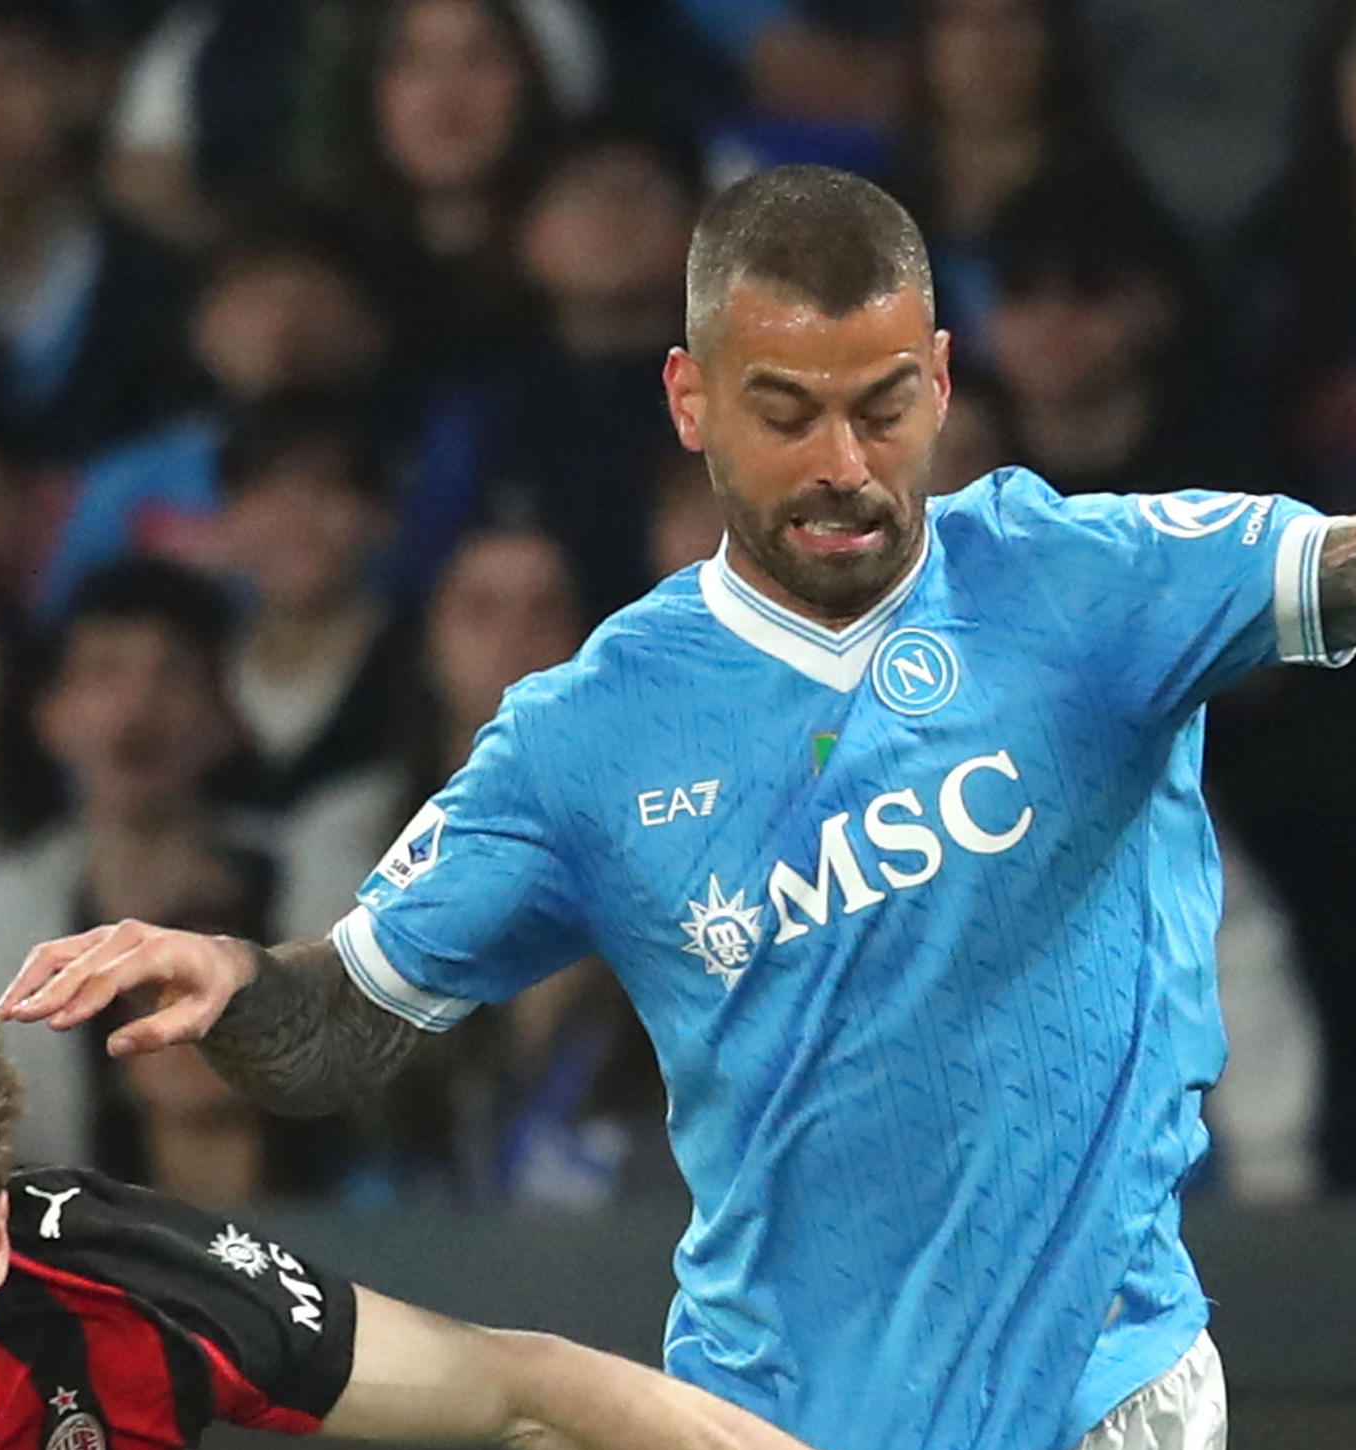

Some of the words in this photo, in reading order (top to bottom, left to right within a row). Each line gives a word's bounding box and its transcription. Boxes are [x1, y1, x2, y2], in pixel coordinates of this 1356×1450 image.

[891, 648, 936, 696] N
[637, 778, 720, 827] EA7
[766, 749, 1034, 945] MSC
